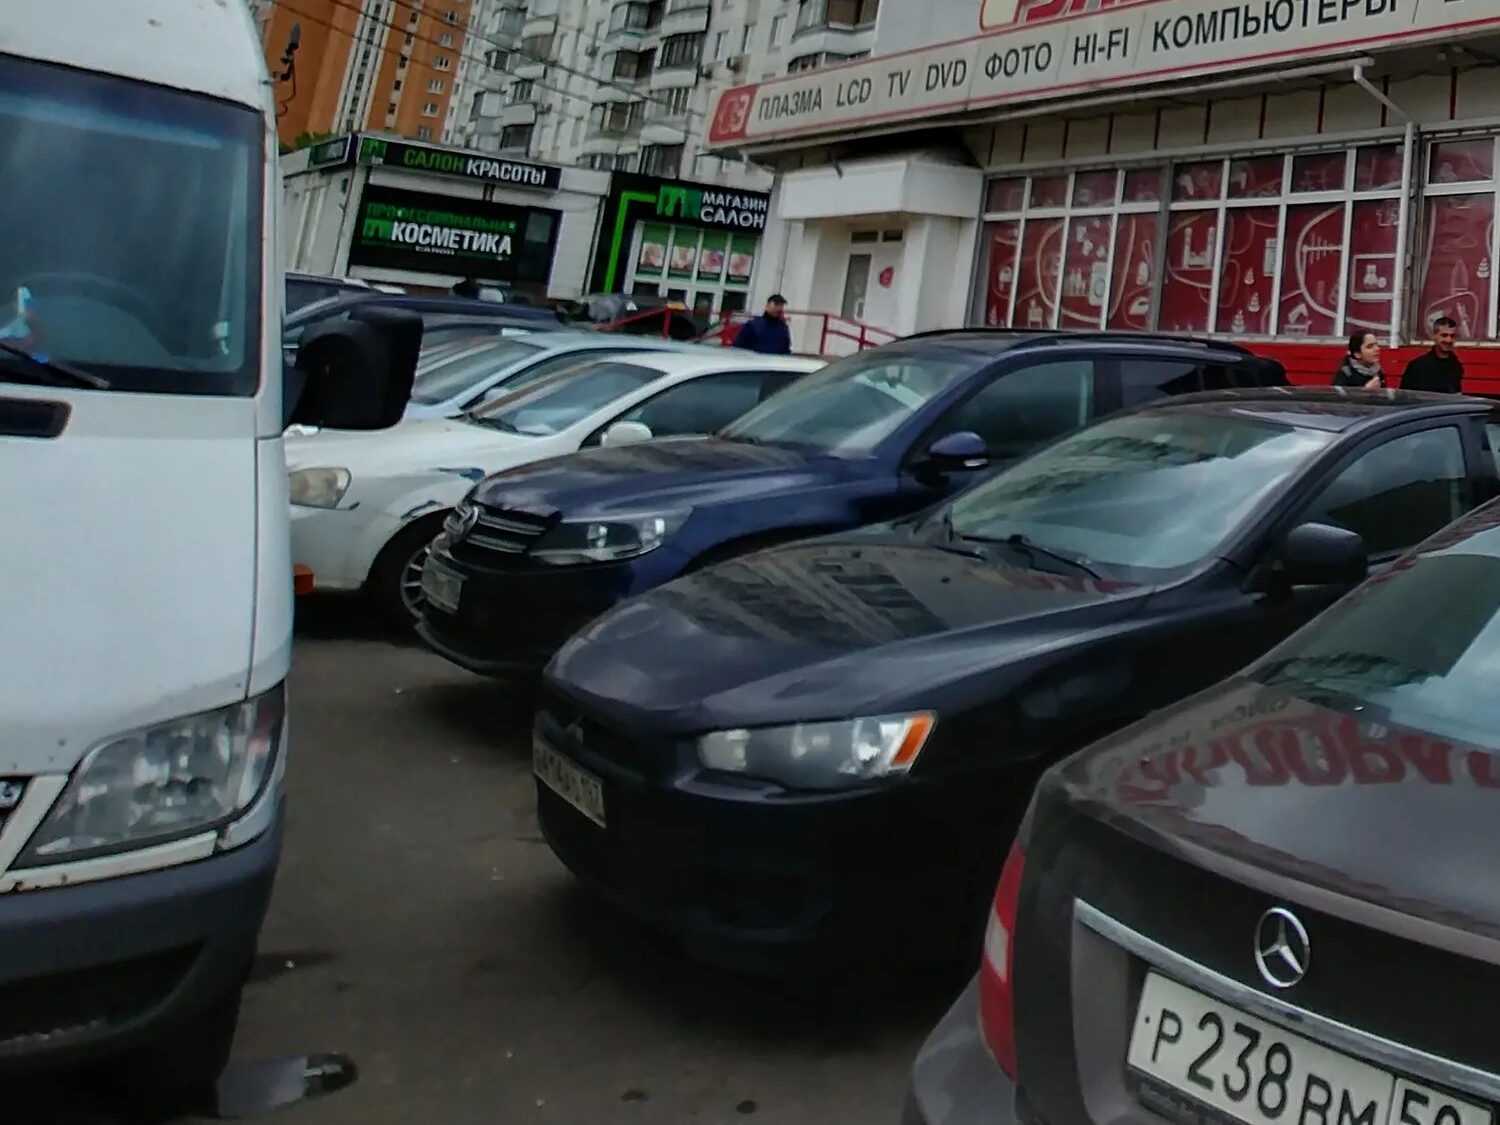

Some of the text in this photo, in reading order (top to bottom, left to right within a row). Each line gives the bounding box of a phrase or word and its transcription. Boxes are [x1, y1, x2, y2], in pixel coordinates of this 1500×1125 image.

[758, 87, 822, 121] ПЛАЗМА
[836, 77, 872, 107] LCD
[888, 72, 909, 97] TV
[925, 59, 967, 92] DVD
[985, 41, 1052, 81] ФОТО
[1073, 27, 1129, 67] HI-FI
[404, 148, 463, 172] САЛОН
[467, 159, 546, 186] КРАСОТЫ
[701, 207, 765, 228] САЛОН
[702, 192, 767, 211] МАГАЗИН
[391, 221, 512, 255] КОСМЕТИКА
